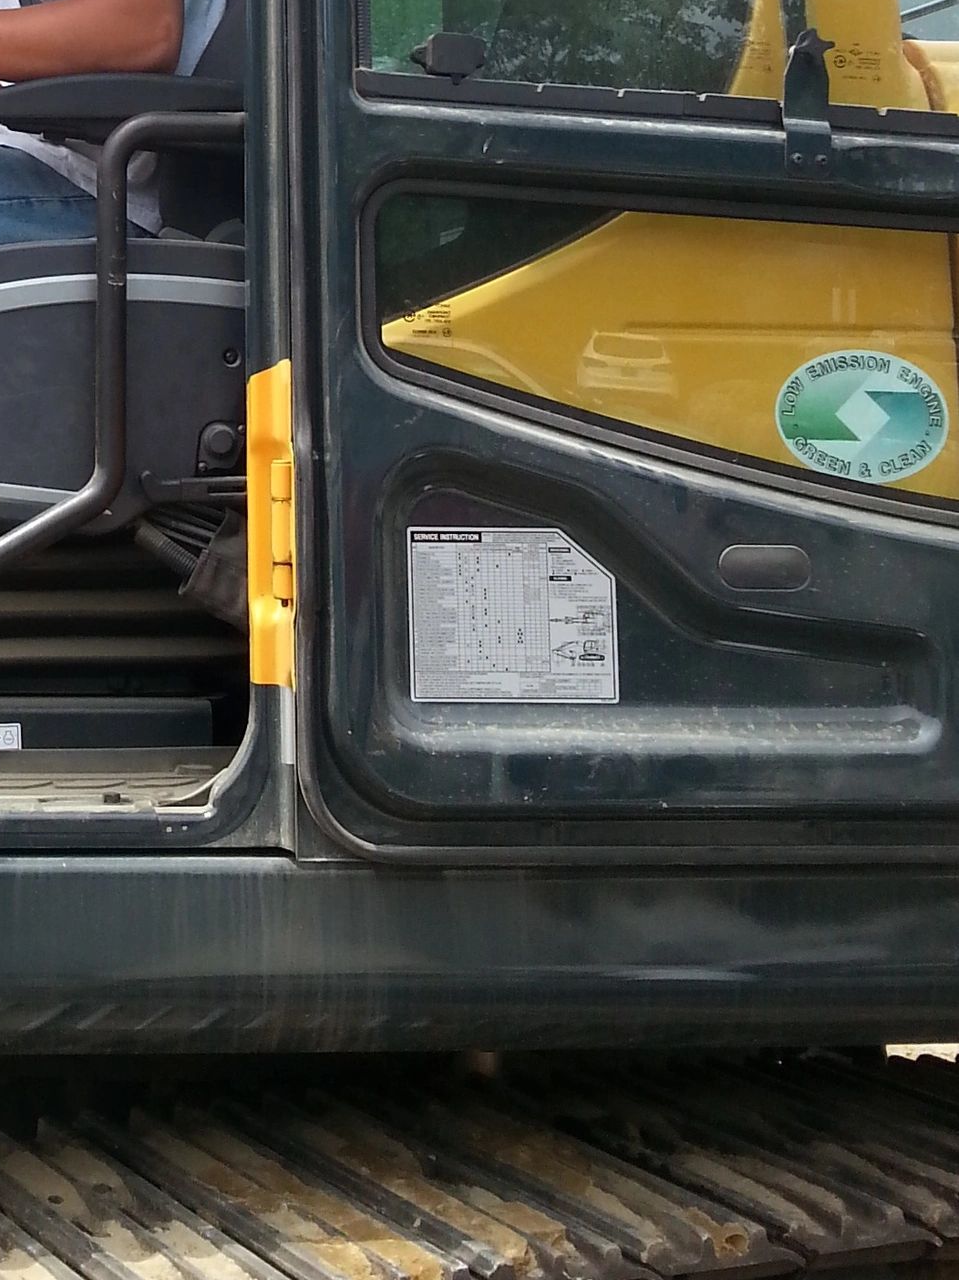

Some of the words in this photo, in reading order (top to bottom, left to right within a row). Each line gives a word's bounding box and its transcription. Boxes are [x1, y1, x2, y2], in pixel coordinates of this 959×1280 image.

[781, 376, 804, 417] LOW
[805, 355, 891, 381] EMISSION
[897, 366, 943, 428] ENGINE
[792, 436, 851, 475] GREEN
[858, 463, 873, 478] &
[878, 440, 932, 477] CLEAN
[413, 533, 439, 541] SERVICE
[439, 533, 480, 541] INSTRUCTION
